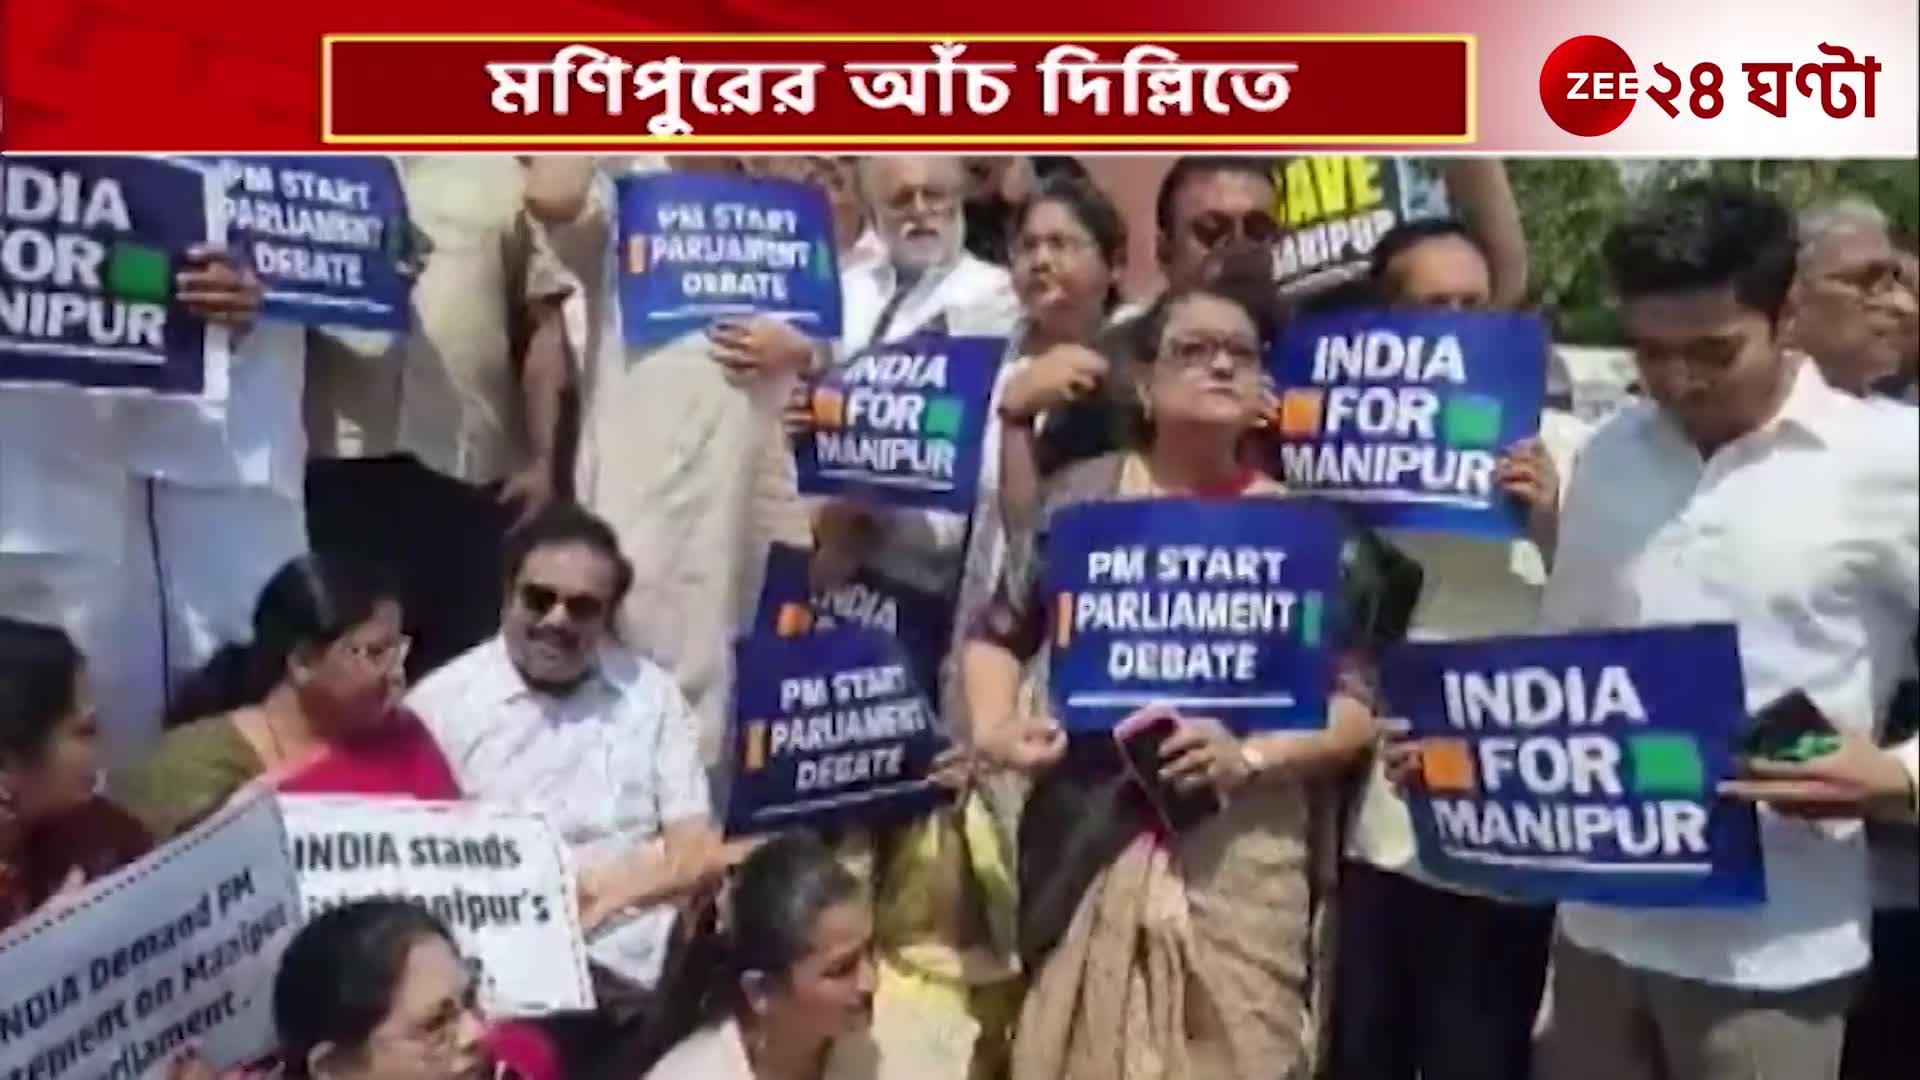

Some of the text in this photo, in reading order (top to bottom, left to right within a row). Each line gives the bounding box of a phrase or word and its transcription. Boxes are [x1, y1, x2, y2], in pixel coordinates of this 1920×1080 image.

[0, 167, 131, 232] DIA
[279, 170, 370, 210] START
[224, 196, 383, 248] PARLIAMENT
[657, 203, 797, 233] PM START
[0, 229, 105, 290] OR
[255, 241, 364, 287] DEBATE
[651, 234, 811, 267] PARLIAMENT
[682, 271, 788, 302] DEBATE
[1312, 331, 1467, 384] INDIA
[846, 388, 925, 430] FOR
[1325, 387, 1439, 438] FOR
[815, 436, 957, 478] MANIPUR
[1281, 443, 1496, 495] MANIPUR
[1088, 545, 1288, 584] PM START
[1075, 590, 1297, 633] PARLIAMENT
[1107, 642, 1259, 681] DEBATE
[780, 665, 907, 711] PM START
[1443, 665, 1648, 729] INDIA
[771, 697, 926, 755] PARLIAMENT
[796, 744, 904, 792] DEBATE
[1478, 736, 1622, 795] FOR
[1432, 800, 1707, 855] MANIPUR
[295, 832, 521, 870] INDIA stands
[89, 892, 212, 991] Demand
[217, 866, 255, 917] PM
[134, 976, 174, 1017] on
